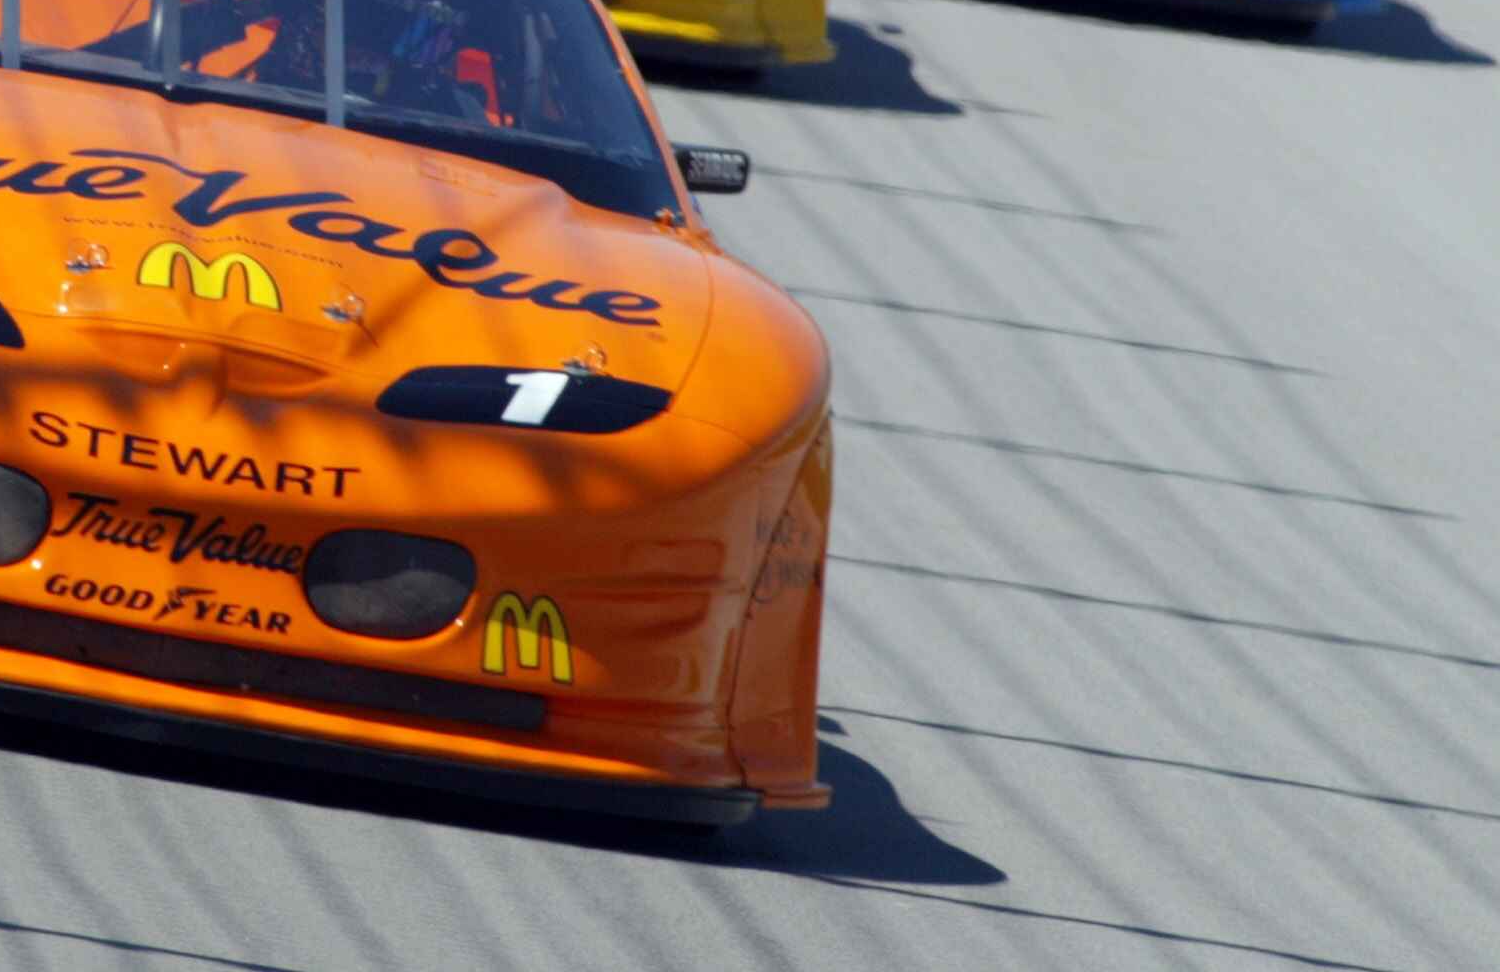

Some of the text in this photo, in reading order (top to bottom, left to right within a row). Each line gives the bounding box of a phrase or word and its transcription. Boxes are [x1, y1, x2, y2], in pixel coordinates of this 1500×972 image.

[69, 148, 663, 327] Value
[500, 368, 571, 426] 1
[29, 410, 362, 498] STEWART
[49, 491, 305, 577] True Value
